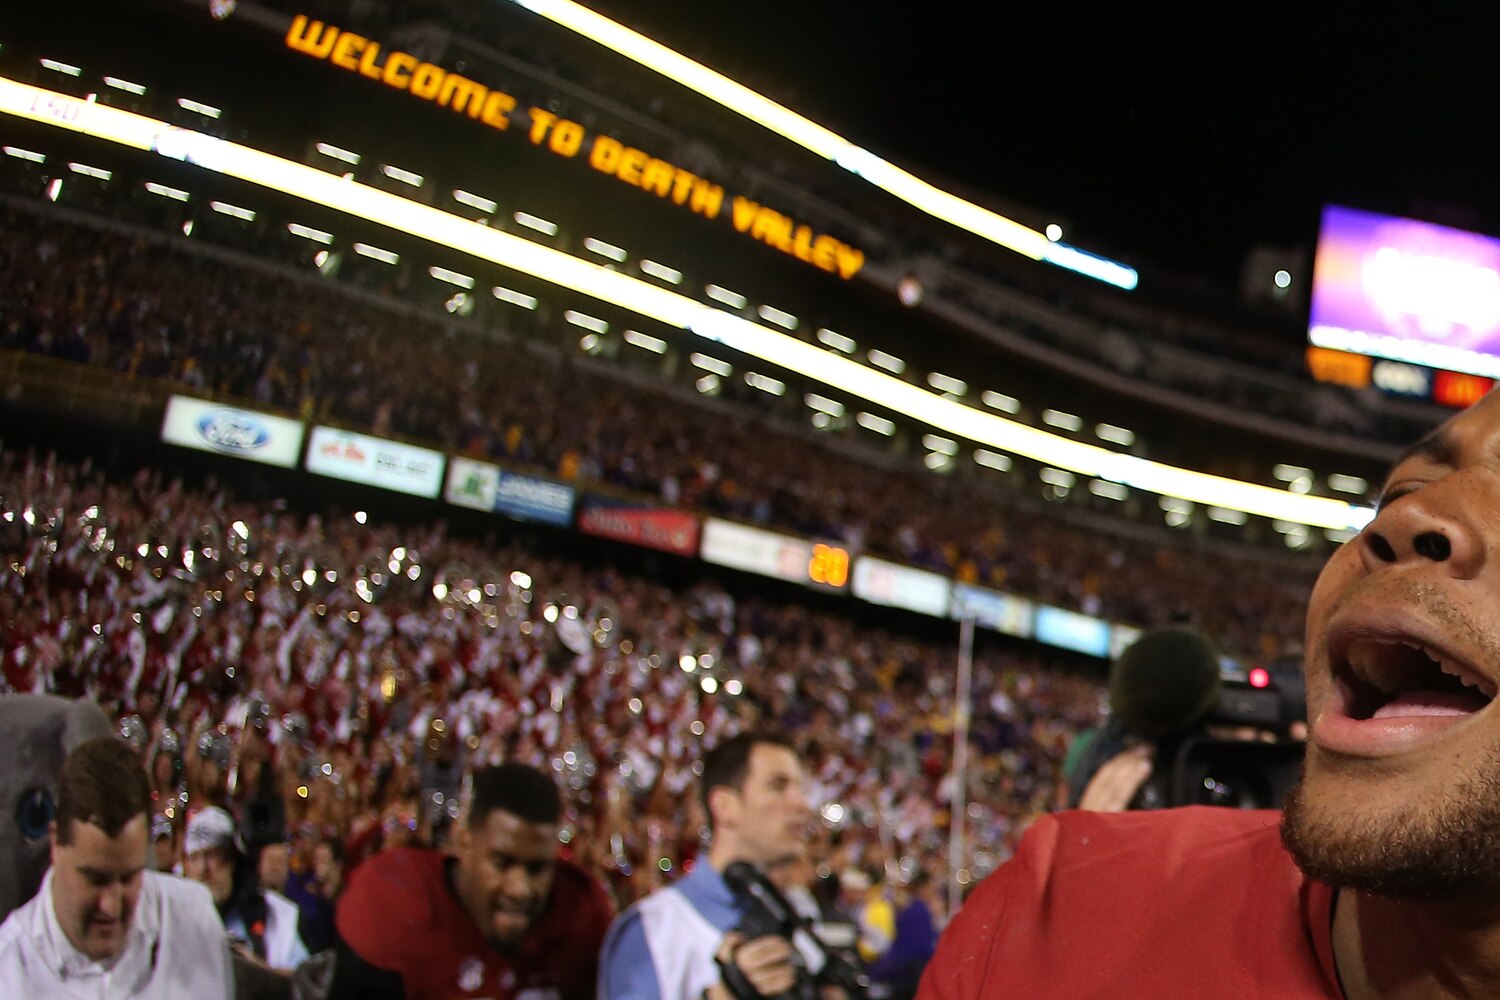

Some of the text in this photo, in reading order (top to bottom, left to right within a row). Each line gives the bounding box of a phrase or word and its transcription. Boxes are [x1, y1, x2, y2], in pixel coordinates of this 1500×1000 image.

[286, 14, 864, 280] WELCOME TO DEATH VALLEY
